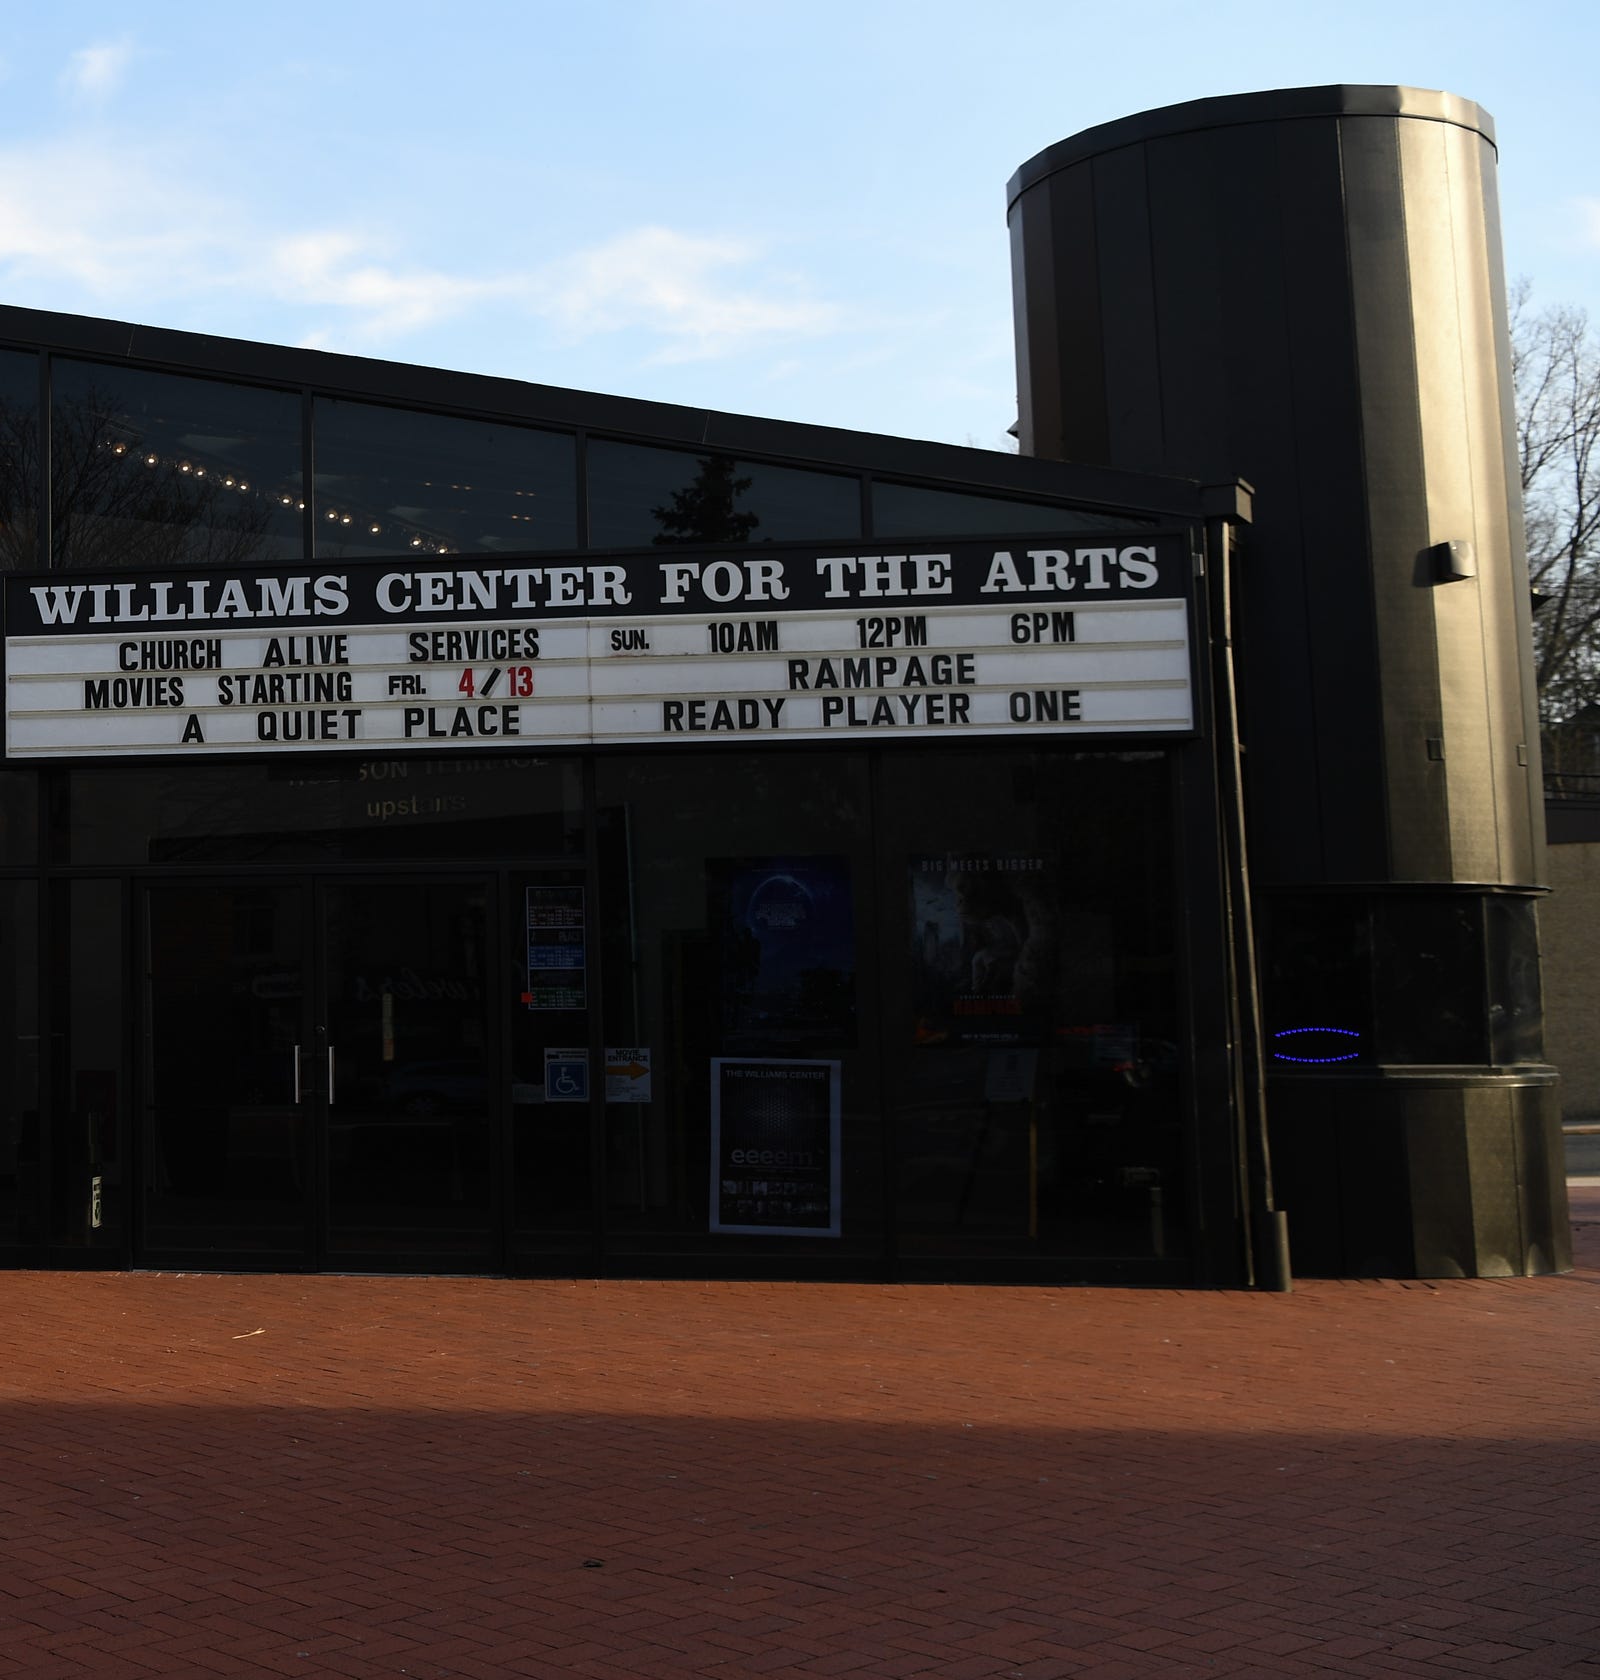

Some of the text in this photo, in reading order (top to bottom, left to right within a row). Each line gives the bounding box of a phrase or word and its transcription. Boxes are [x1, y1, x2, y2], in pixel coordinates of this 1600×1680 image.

[30, 546, 1160, 625] WILLIAMS CENTER FOR THE ARTS
[118, 628, 540, 671] CHURCH ALIVE SERVICES
[610, 611, 1076, 653] SUN. 10AM 12PM 6PM
[84, 666, 534, 709] MOVIES STARTING FRI. 4/13
[787, 654, 976, 690] RAMPAGE
[182, 705, 521, 744] A QUIET PLACE
[663, 690, 1081, 732] READY PLAYER ONE
[921, 860, 943, 872] BIG
